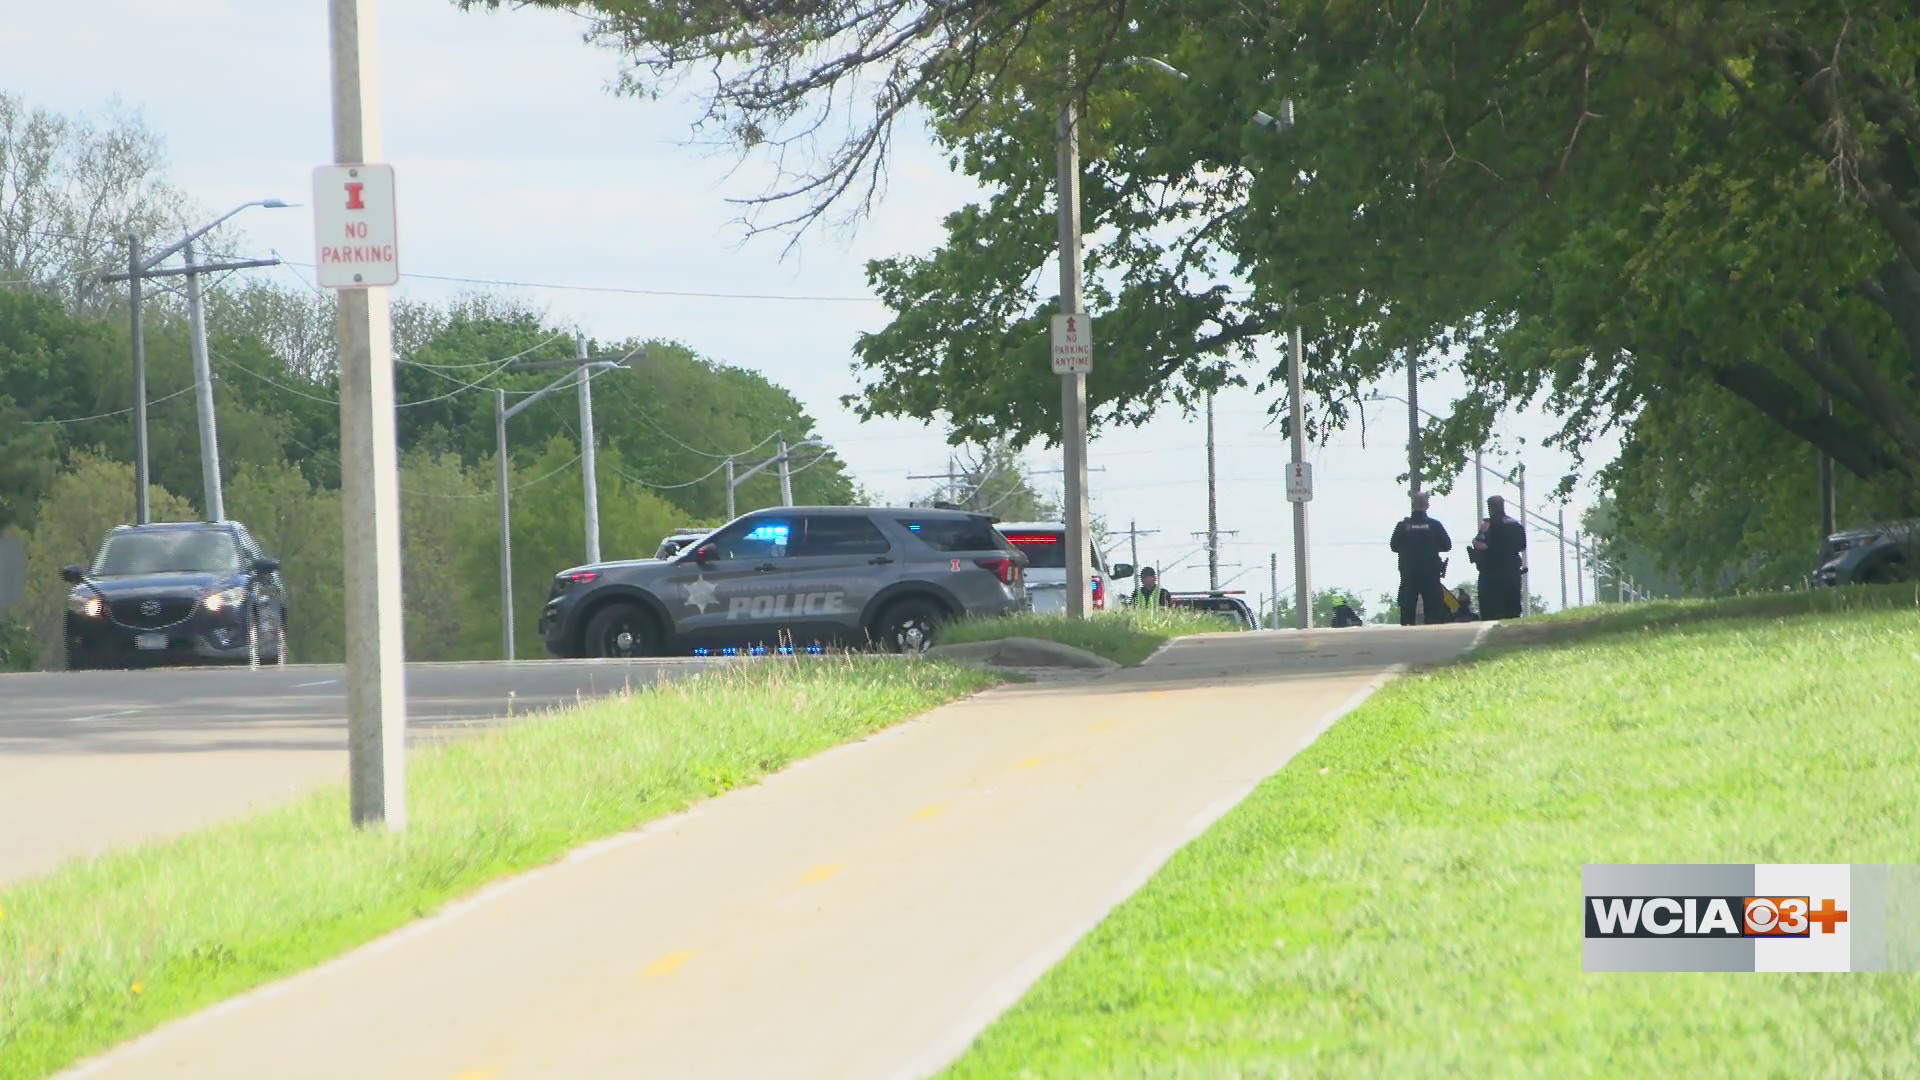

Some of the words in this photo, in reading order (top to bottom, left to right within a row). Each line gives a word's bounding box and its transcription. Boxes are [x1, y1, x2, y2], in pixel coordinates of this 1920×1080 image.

[344, 182, 365, 209] I
[345, 221, 367, 238] NO
[321, 245, 392, 263] PARKING
[1066, 334, 1077, 343] NO
[1055, 345, 1089, 354] PARKING
[1055, 357, 1089, 366] ANYTIME
[726, 591, 845, 621] POLICE
